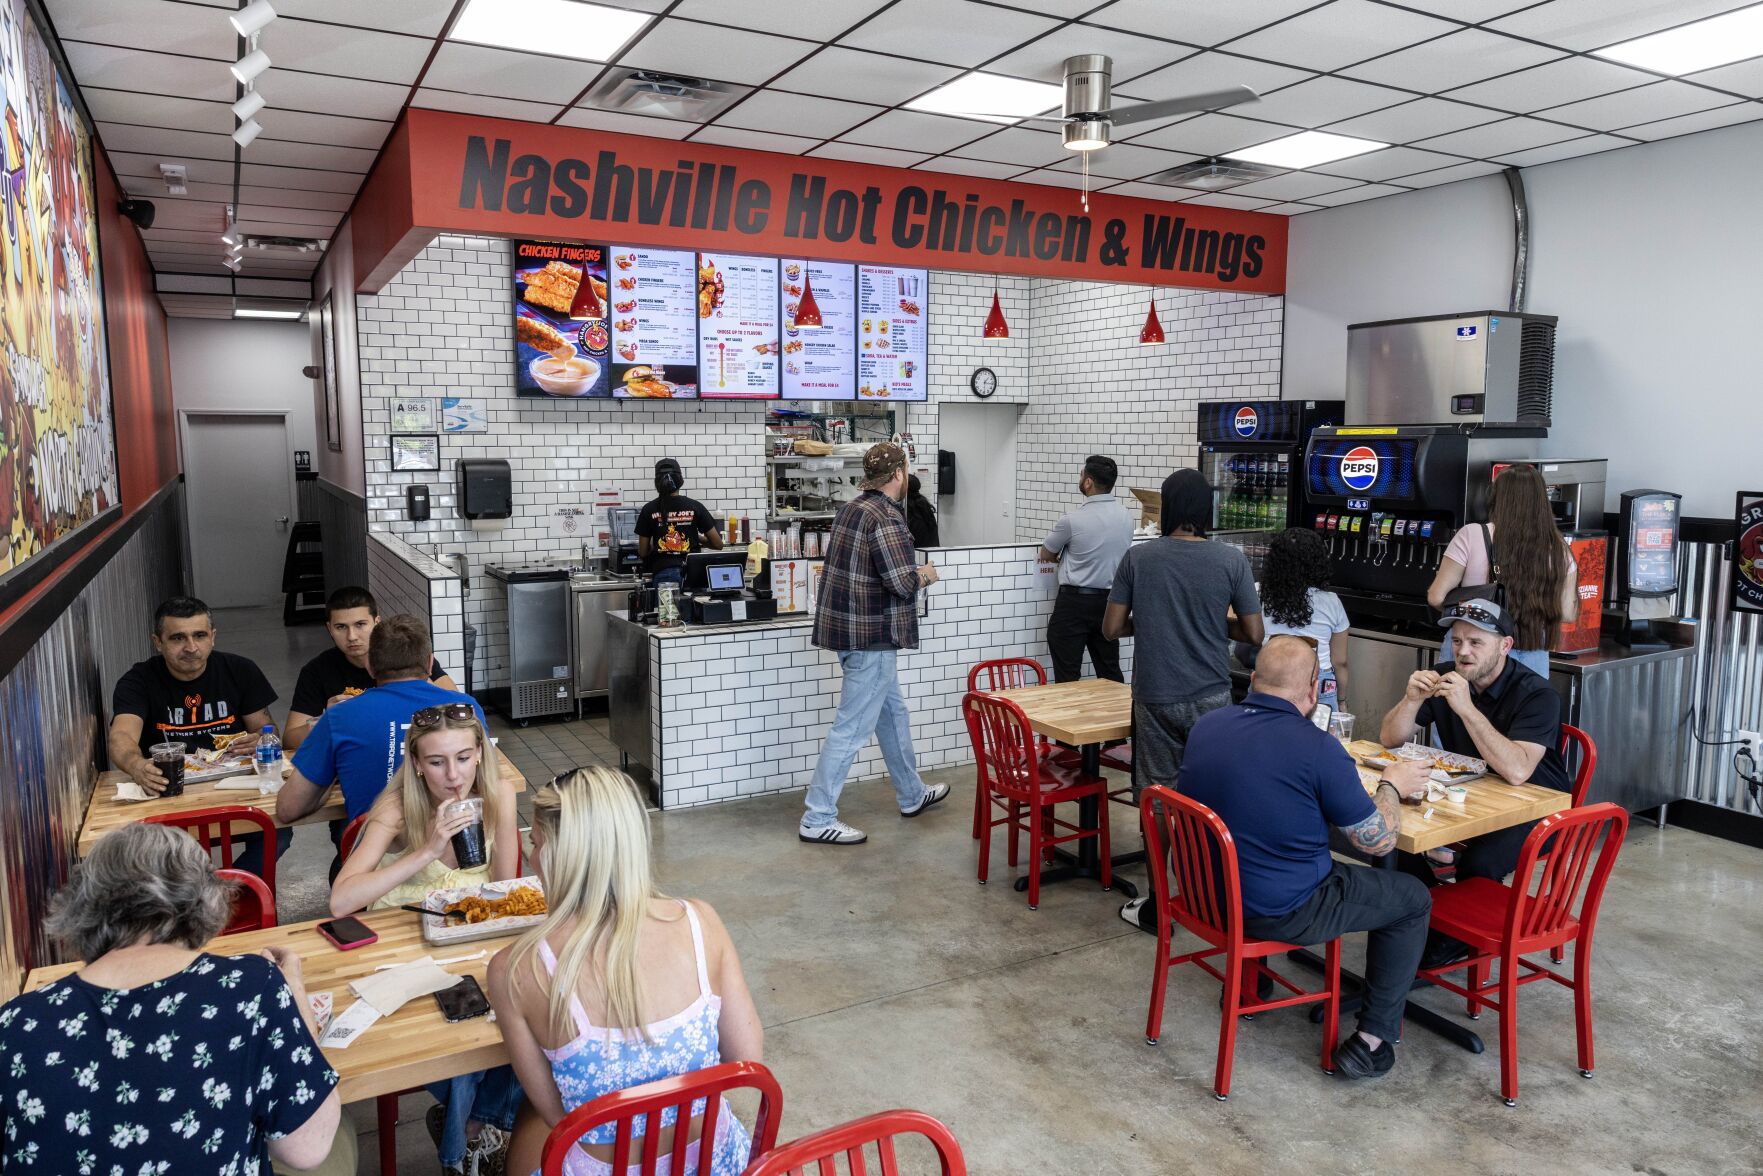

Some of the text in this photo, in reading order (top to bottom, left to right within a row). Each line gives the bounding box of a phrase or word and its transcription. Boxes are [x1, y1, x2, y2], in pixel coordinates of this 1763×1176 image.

[458, 135, 1266, 282] Nashville Hot Chicken & Wings
[519, 244, 601, 261] CHICKEN FINGERS
[397, 404, 404, 412] A
[38, 427, 76, 522] NORTH
[1343, 464, 1376, 474] PEPSI
